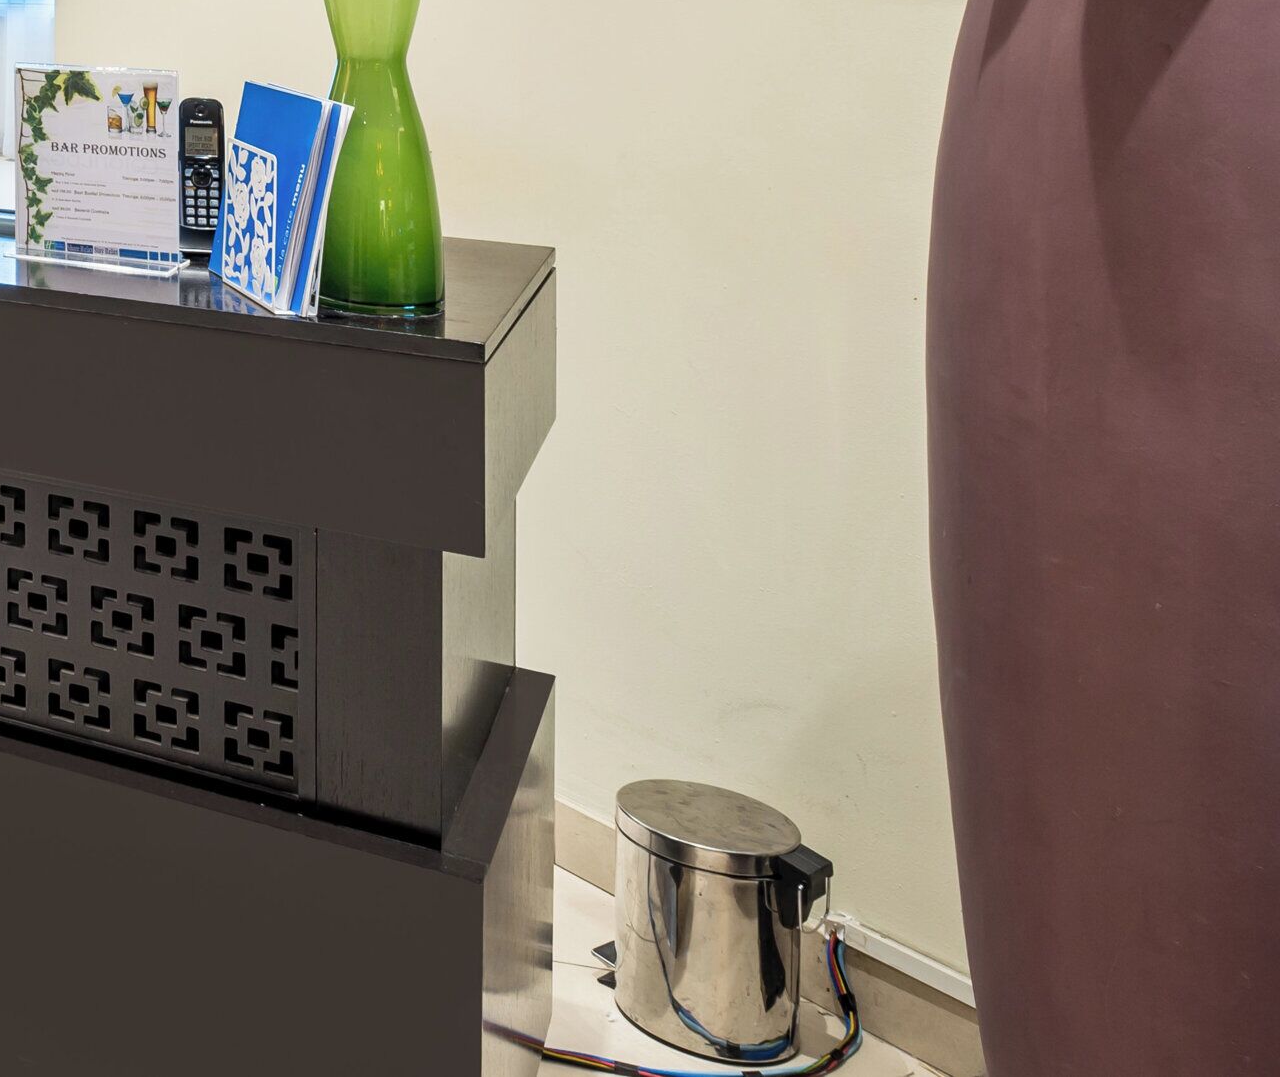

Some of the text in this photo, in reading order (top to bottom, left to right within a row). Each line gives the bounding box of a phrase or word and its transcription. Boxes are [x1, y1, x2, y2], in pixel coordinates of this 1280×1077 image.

[51, 141, 167, 159] BAR PROMOTIONS
[291, 163, 306, 207] menu
